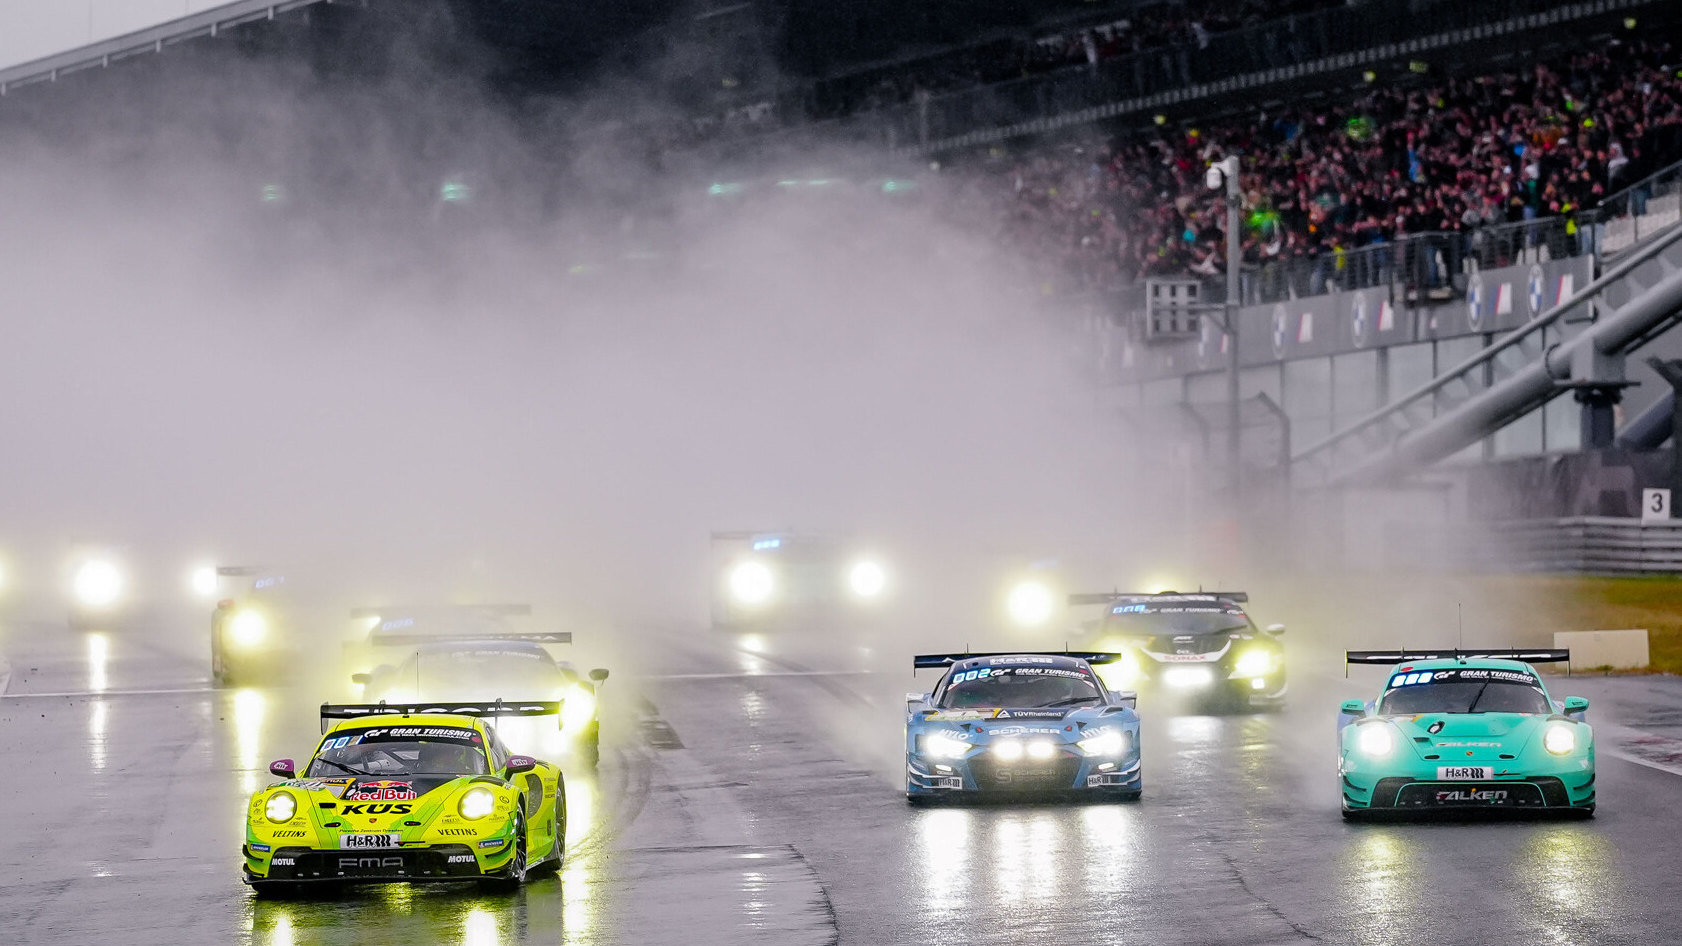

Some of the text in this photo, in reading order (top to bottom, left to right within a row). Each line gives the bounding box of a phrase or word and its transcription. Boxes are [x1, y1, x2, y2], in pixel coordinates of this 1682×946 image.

[1651, 492, 1663, 513] 3
[1043, 669, 1087, 678] TURISMO
[1490, 671, 1535, 682] TURISMO
[423, 728, 472, 738] TURISMO
[1446, 768, 1469, 778] H&R
[1436, 790, 1508, 800] FALKEN
[341, 802, 413, 815] KÜS
[272, 830, 307, 838] VELTINS
[437, 828, 478, 836] VELTINS
[346, 835, 373, 847] H&R
[338, 857, 404, 869] FMA
[447, 855, 475, 863] MOTUL
